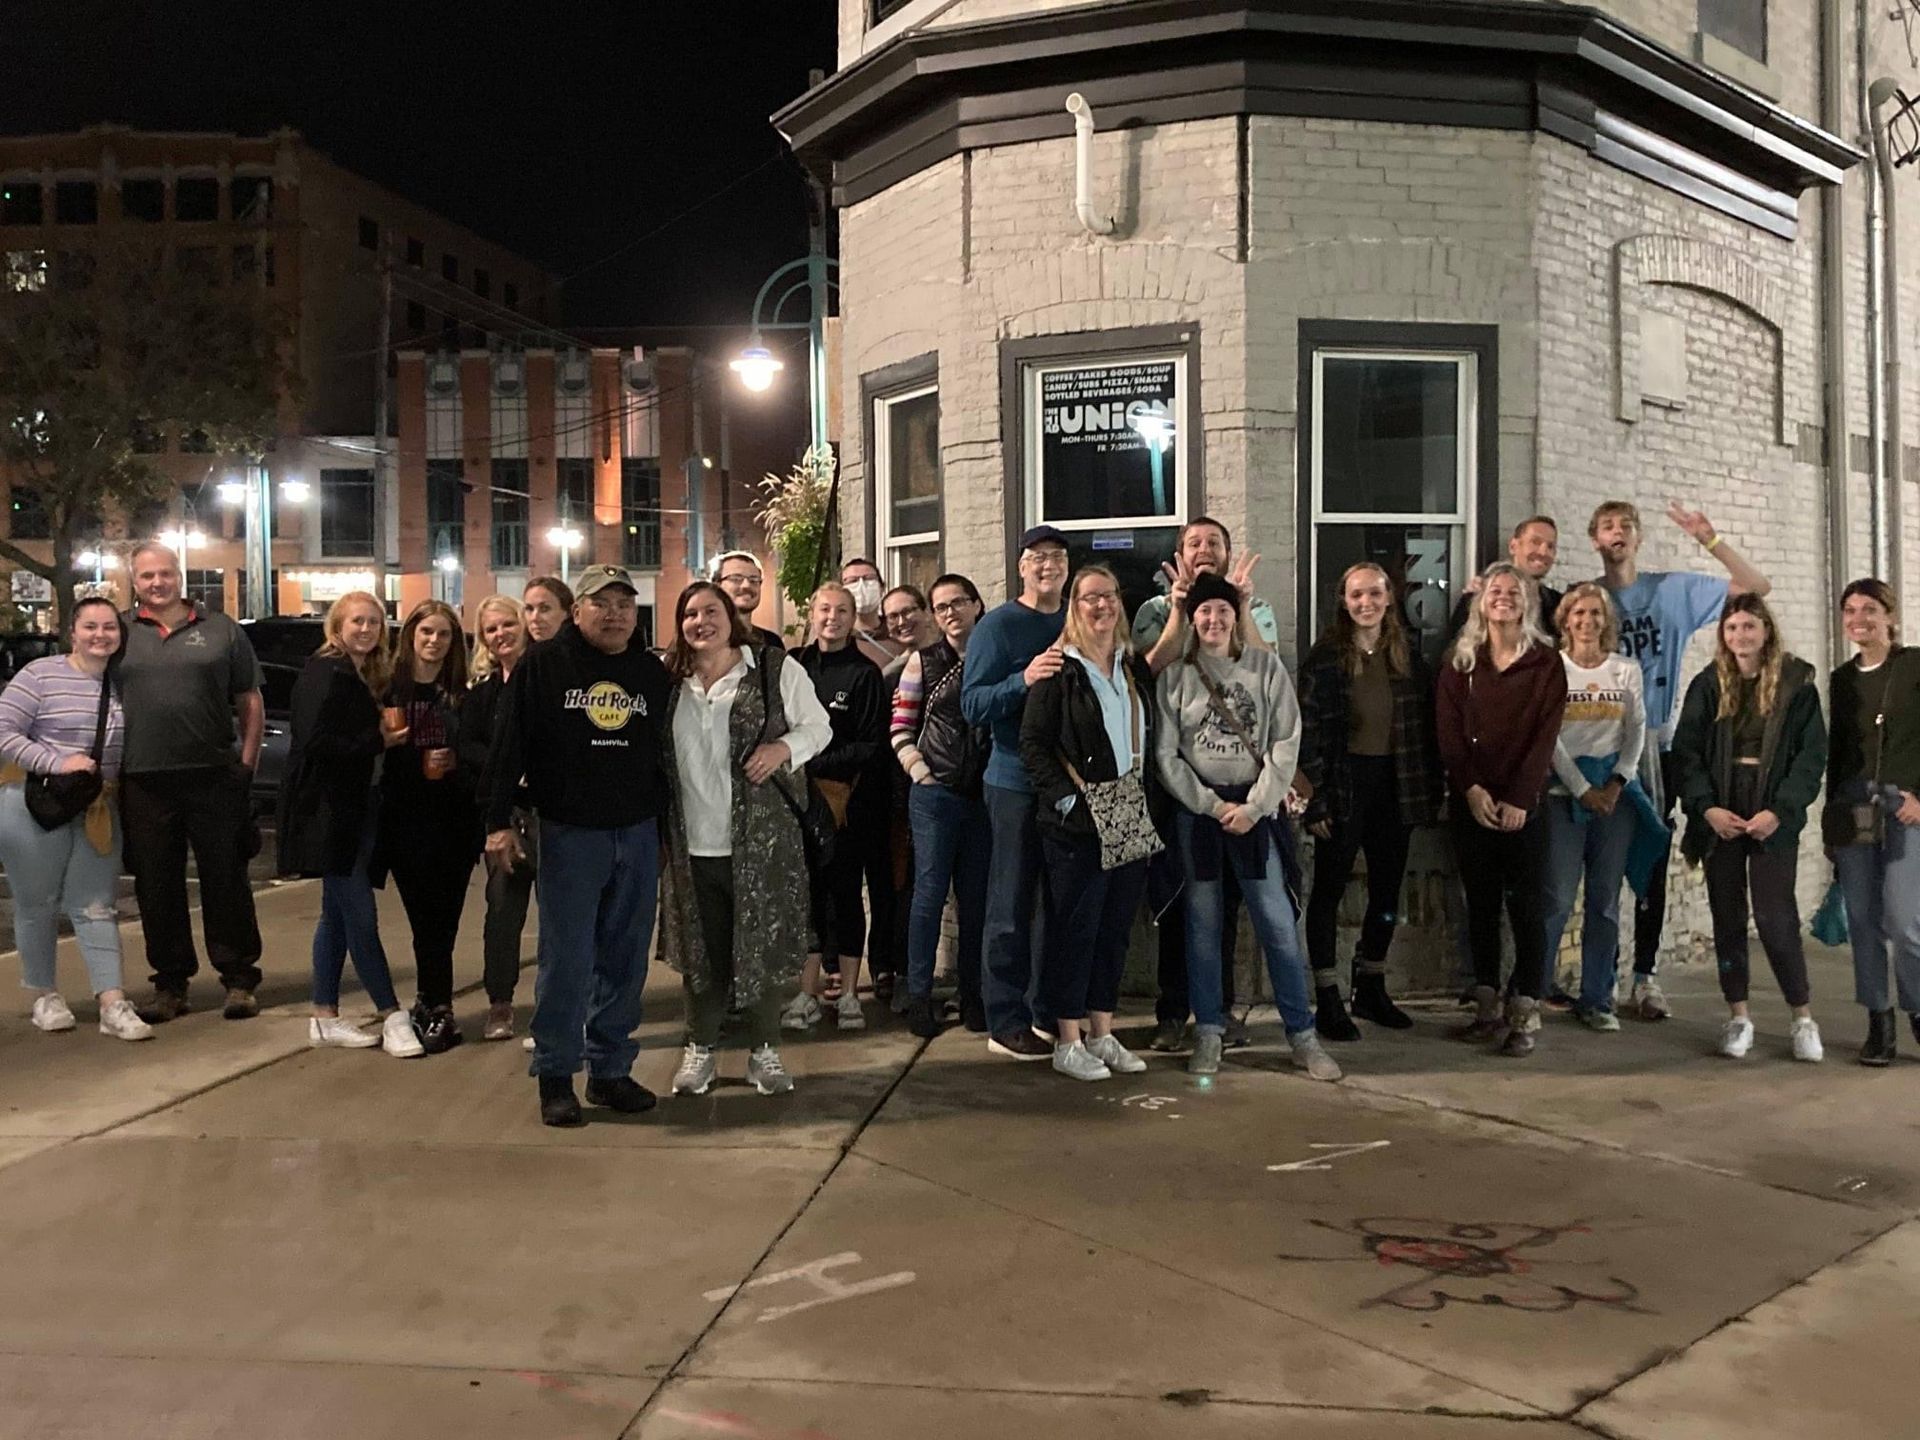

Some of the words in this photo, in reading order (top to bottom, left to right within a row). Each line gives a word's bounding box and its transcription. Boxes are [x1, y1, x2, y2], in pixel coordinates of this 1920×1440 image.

[1110, 365, 1171, 377] GOODS/SOUP
[1045, 390, 1080, 401] BOTTLED
[564, 689, 608, 709] Hard
[610, 691, 648, 716] Rock
[599, 713, 620, 721] CAFE
[591, 739, 629, 747] NASHVILLE
